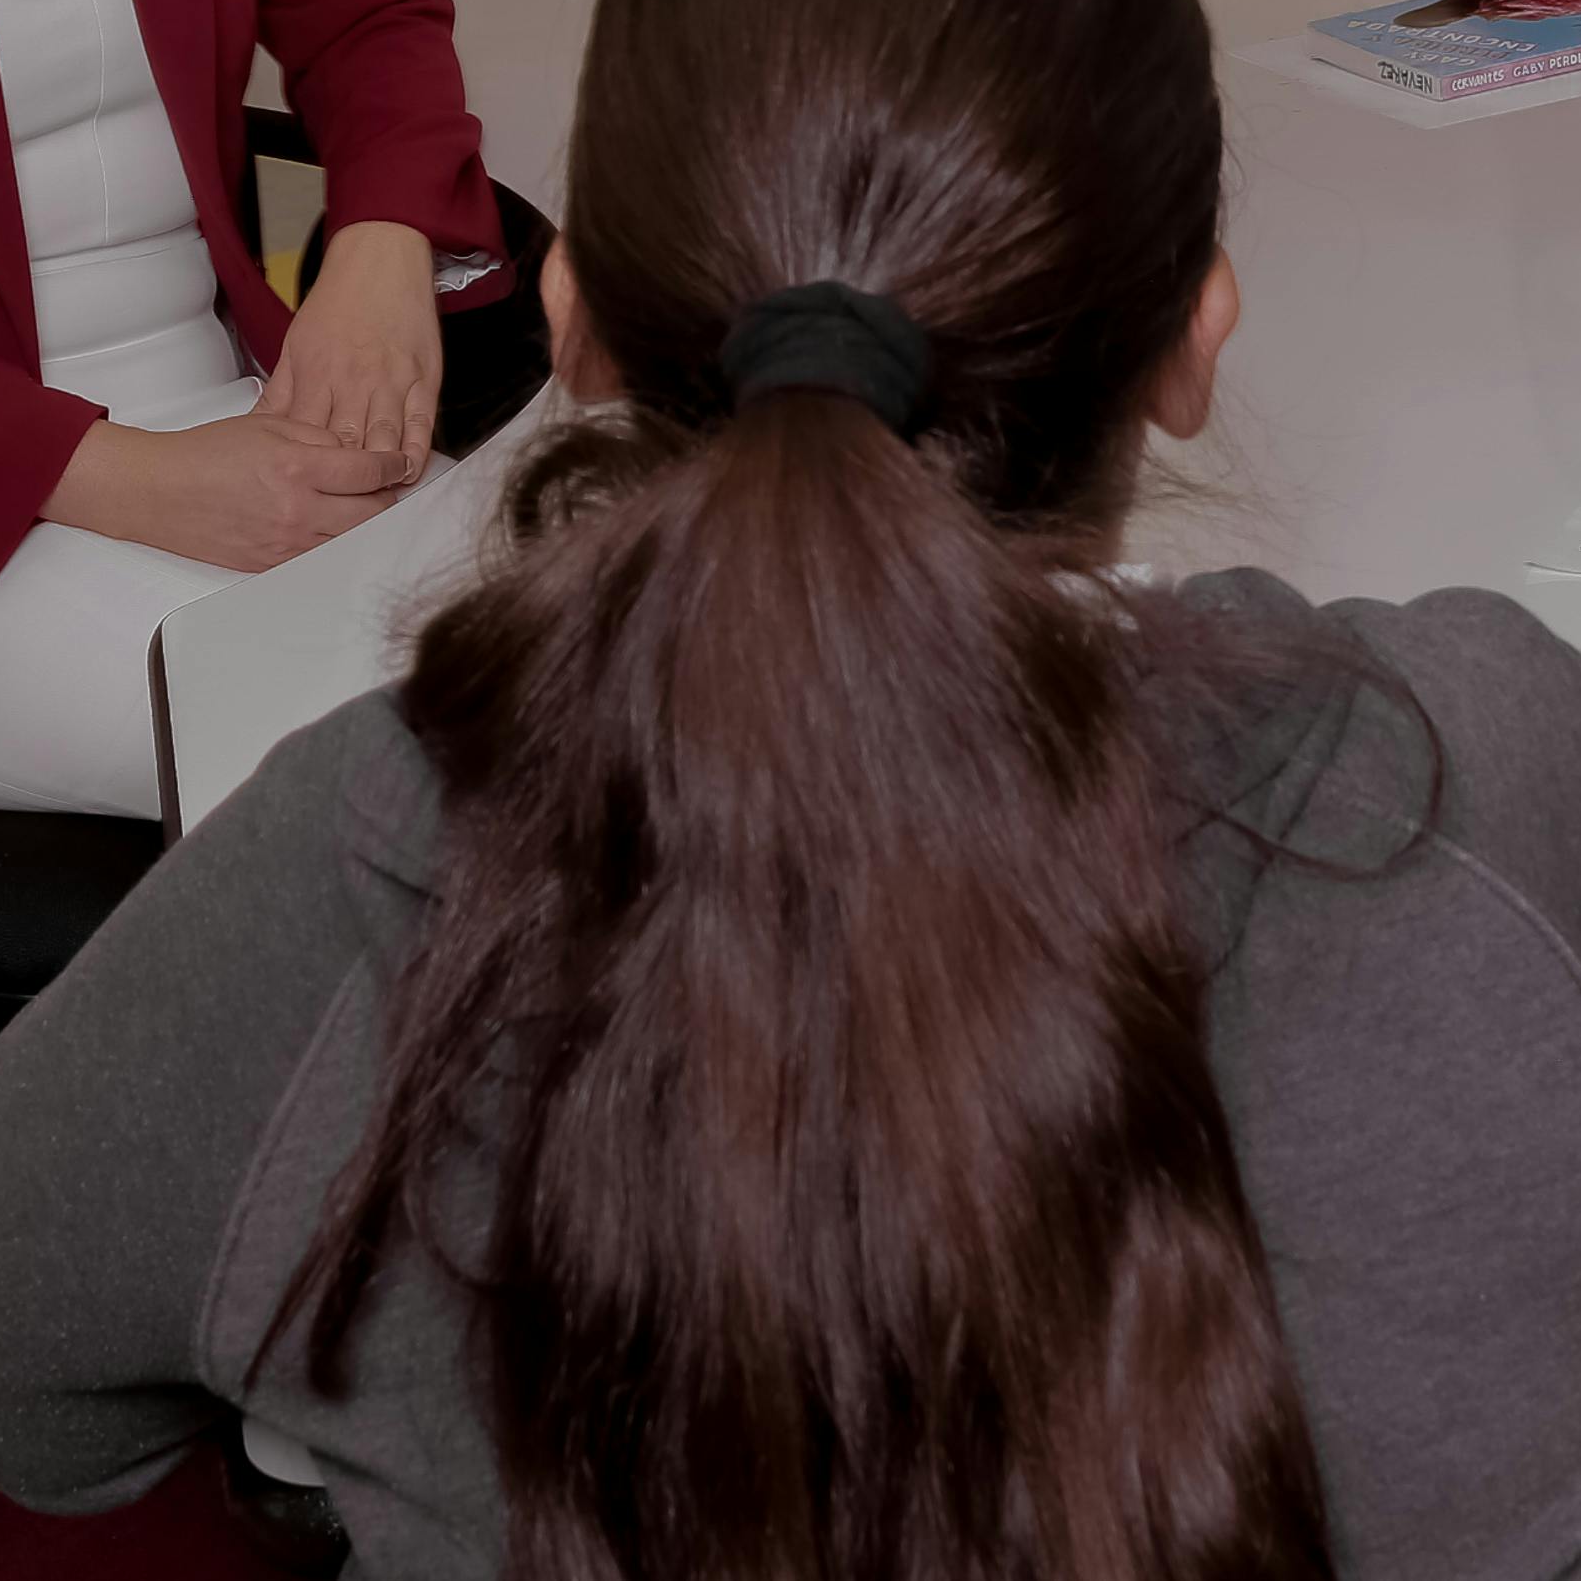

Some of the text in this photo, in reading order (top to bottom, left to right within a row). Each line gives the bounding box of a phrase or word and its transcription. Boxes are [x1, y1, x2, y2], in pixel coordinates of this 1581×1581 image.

[1377, 60, 1434, 94] NEVAREZ
[1452, 69, 1505, 91] CERVANTES
[1513, 62, 1545, 77] GABY
